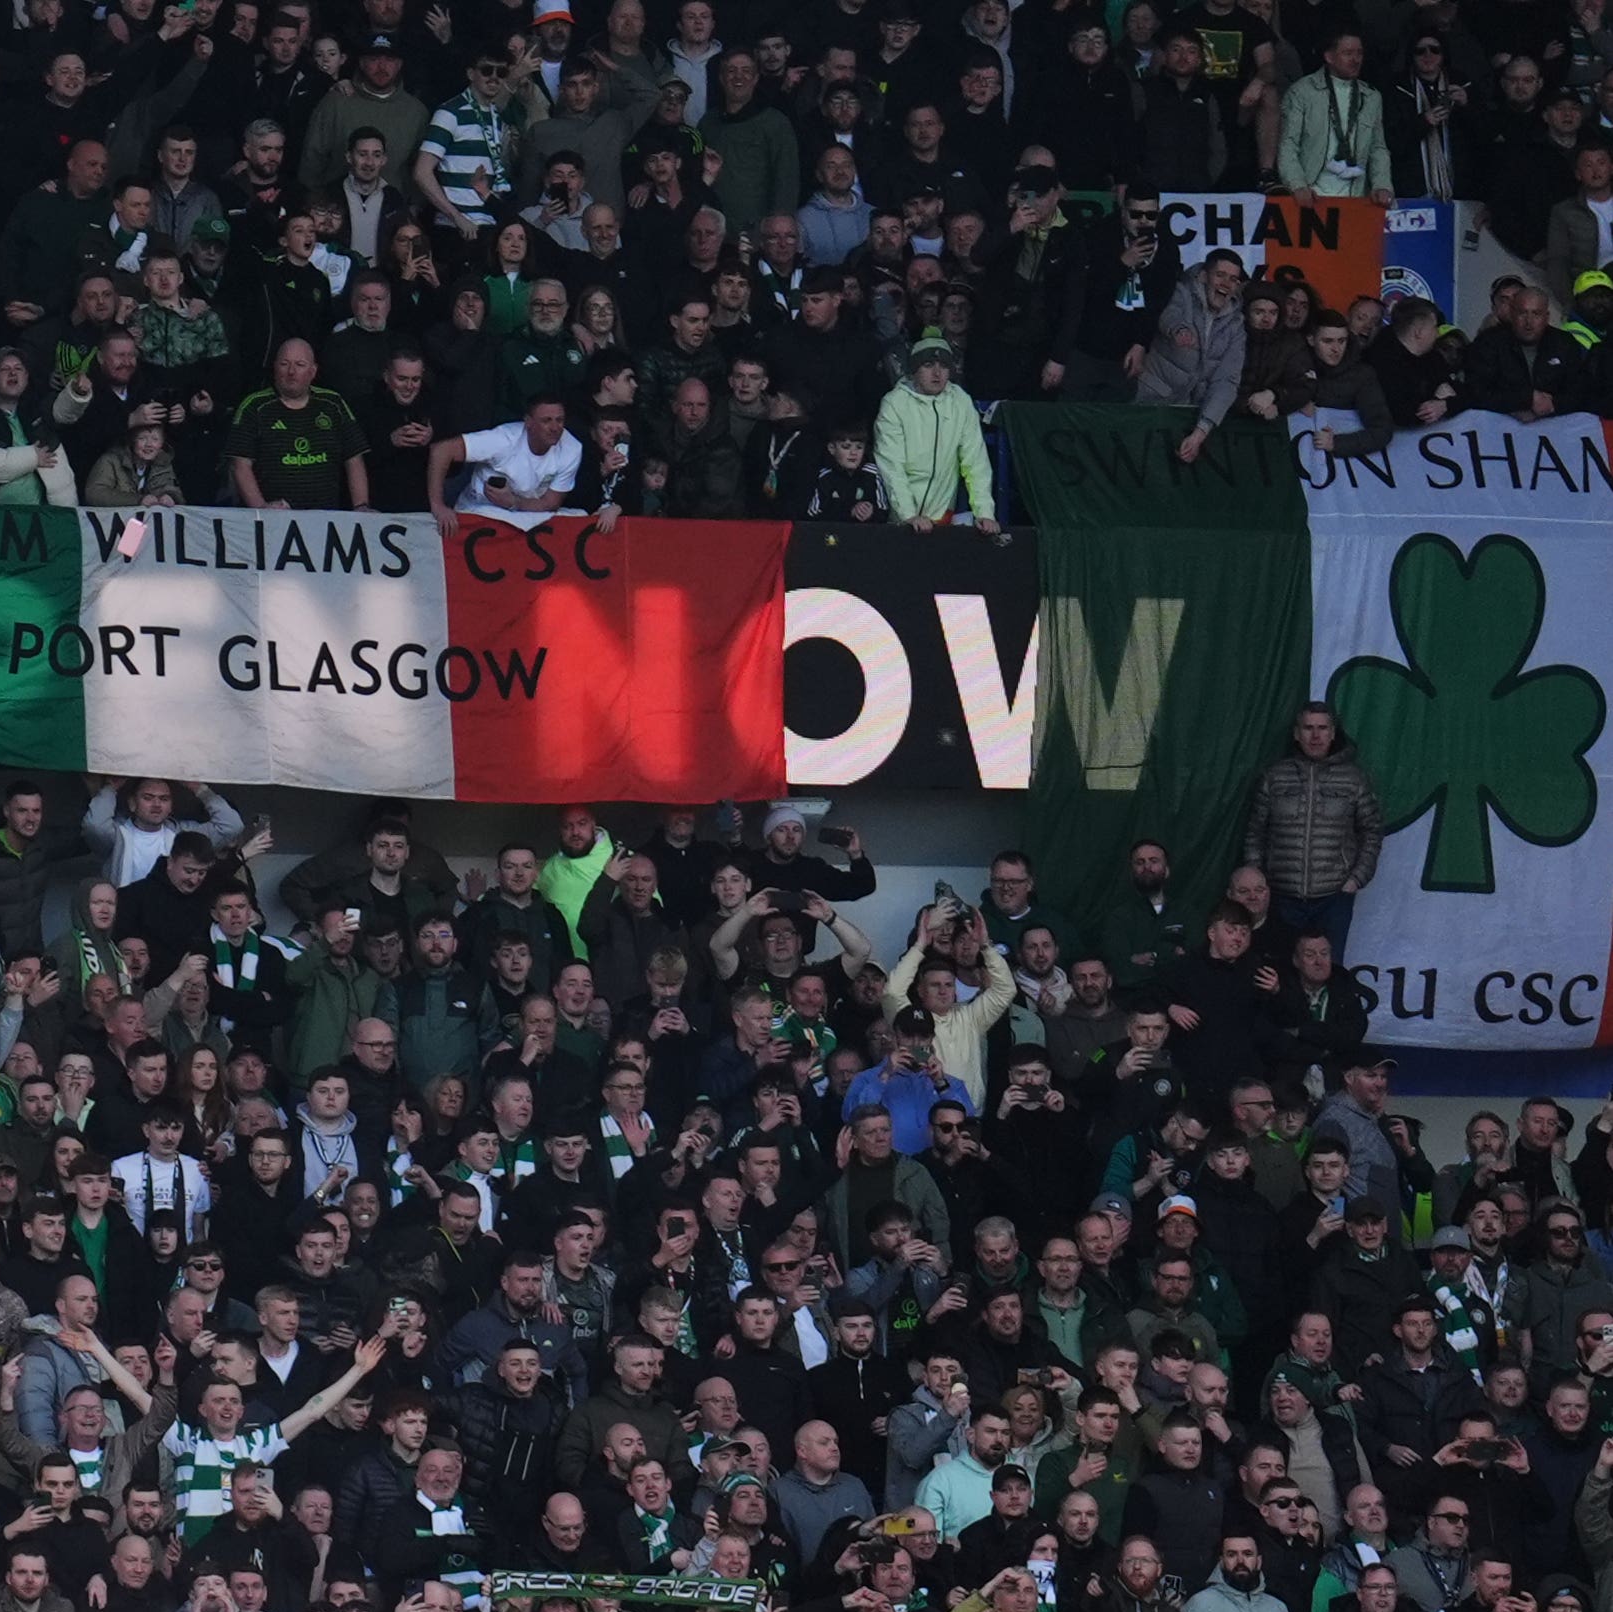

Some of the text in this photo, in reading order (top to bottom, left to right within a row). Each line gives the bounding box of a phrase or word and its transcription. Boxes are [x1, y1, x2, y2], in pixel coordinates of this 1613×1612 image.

[282, 452, 328, 466] dafabet
[87, 511, 411, 578] WILLIAMS
[463, 522, 611, 582] CSC
[8, 621, 548, 702] PORT GLASGOW
